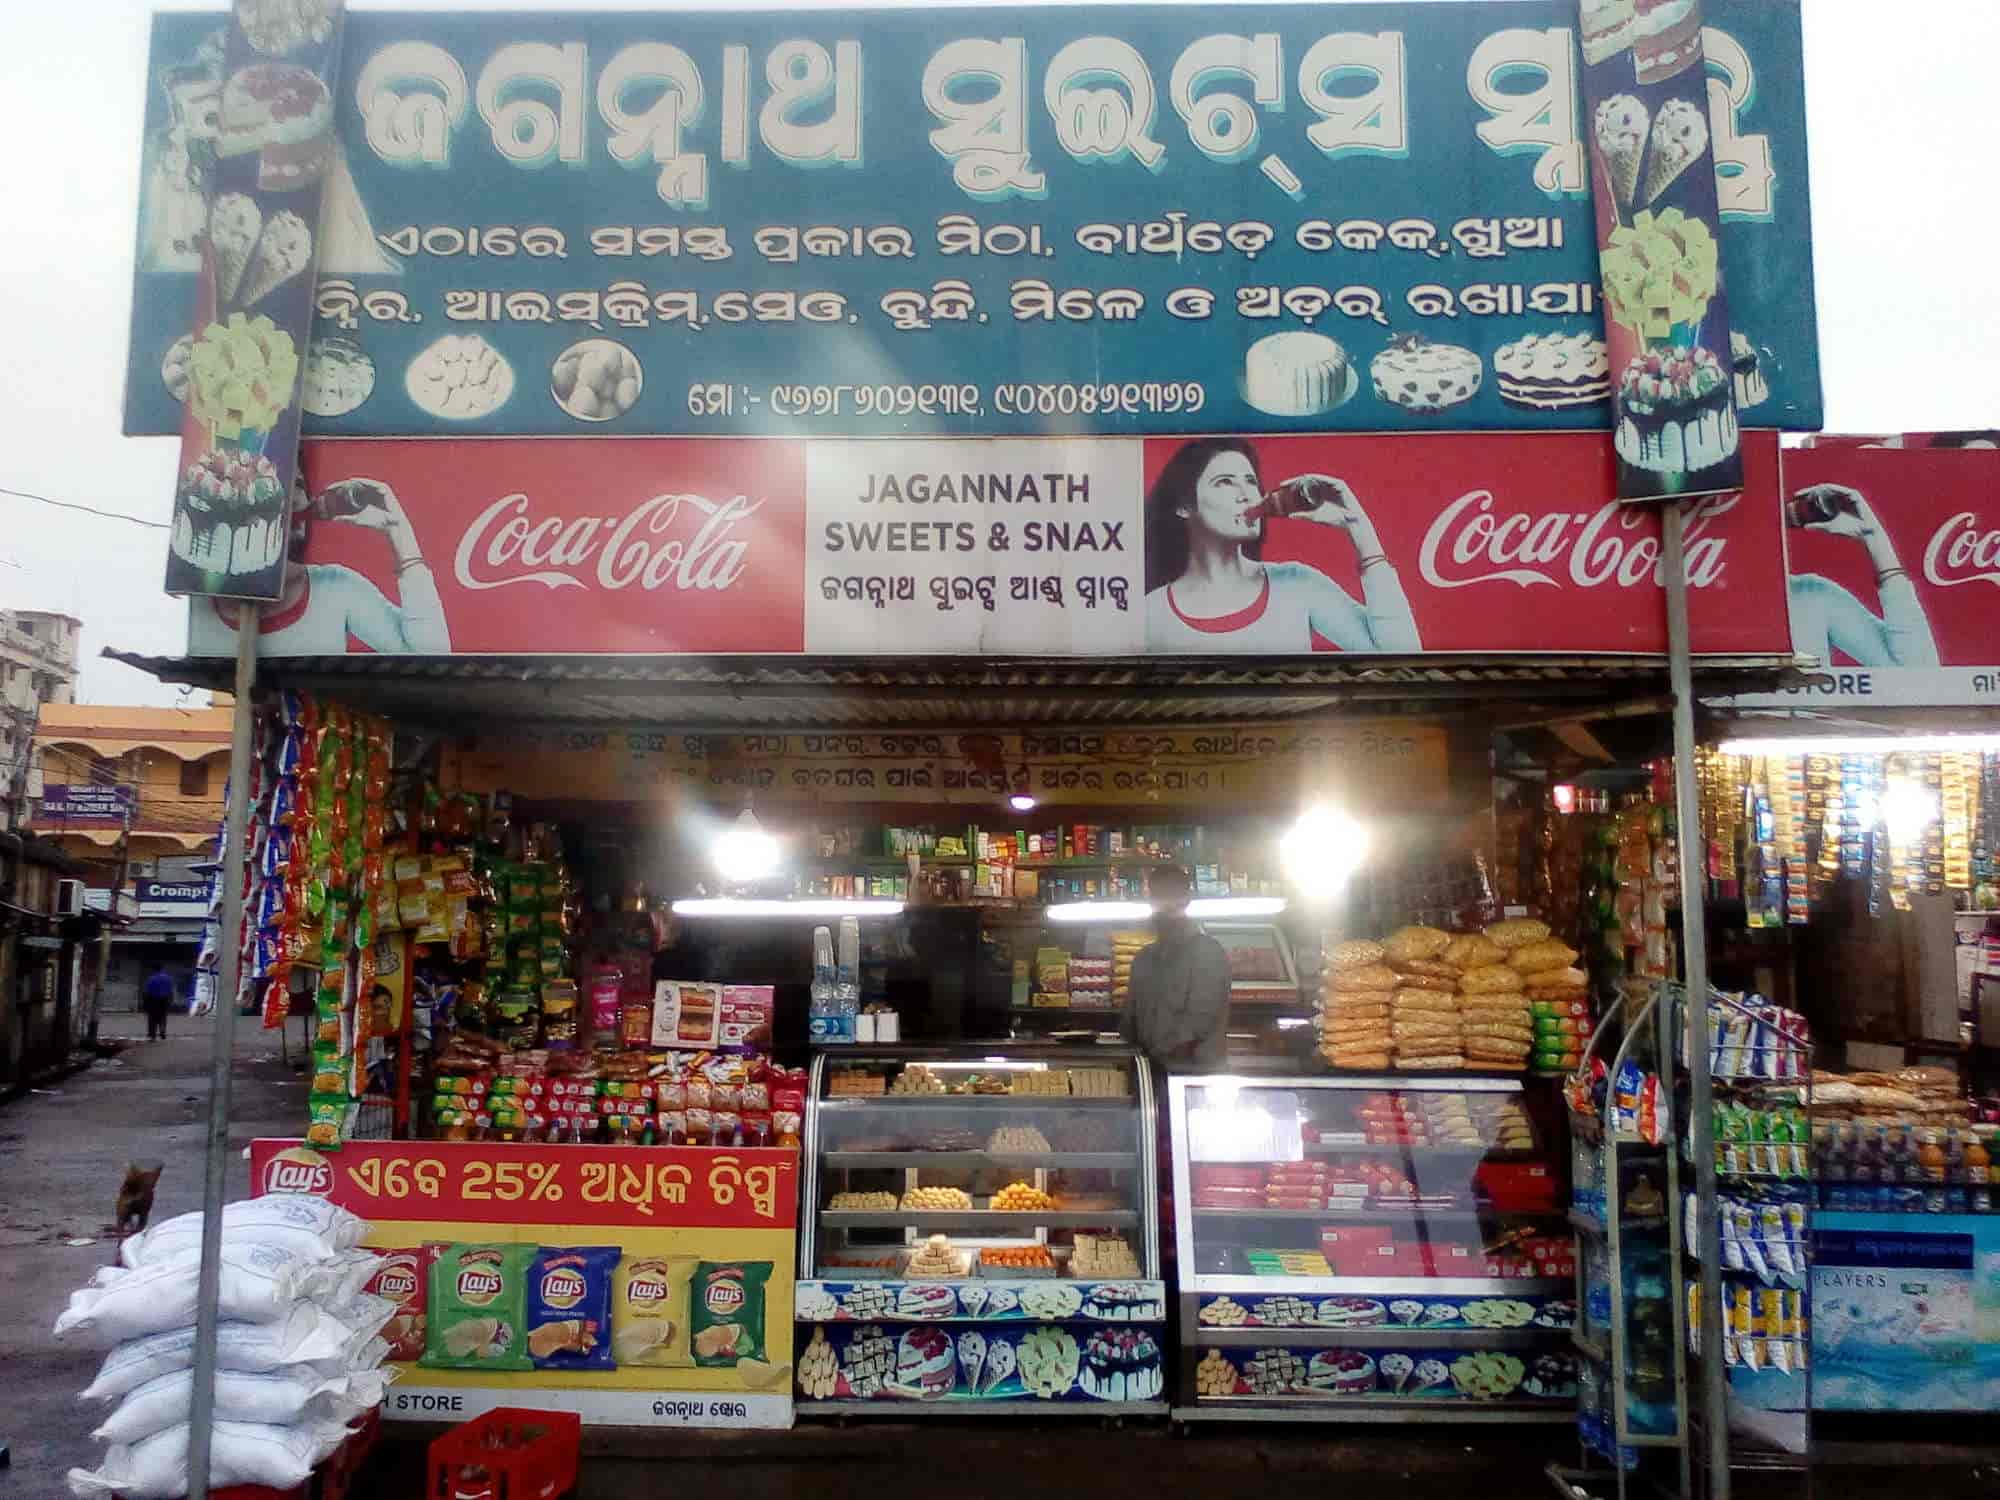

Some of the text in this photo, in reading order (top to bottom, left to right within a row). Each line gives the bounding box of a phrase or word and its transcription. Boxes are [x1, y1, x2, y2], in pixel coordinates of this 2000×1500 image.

[356, 39, 864, 204] ଜଗନ୍ନାଥ
[378, 225, 569, 260] ଏଠାରେ
[590, 225, 734, 262] ସମସ୍ତ
[753, 224, 915, 264] ପ୍ରକାର
[1406, 282, 1606, 320] ରଖାଯା
[858, 473, 1090, 504] JAGANNATH
[455, 493, 768, 592] Coca-Cola
[825, 521, 1124, 552] SWEETS & SNAX
[1417, 488, 1748, 590] Coca-Coa
[821, 576, 915, 609] ଜଗନ୍ନାଥ
[150, 884, 208, 901] Crompt
[268, 1160, 330, 1194] Lay's
[347, 1158, 447, 1198] ଏବେ
[461, 1160, 564, 1200] 25%
[581, 1162, 693, 1216] ଅଧିକ
[460, 1271, 500, 1294] Lay's
[544, 1277, 583, 1298] Lay's
[629, 1279, 667, 1301] Lay's
[398, 1393, 463, 1410] STORE
